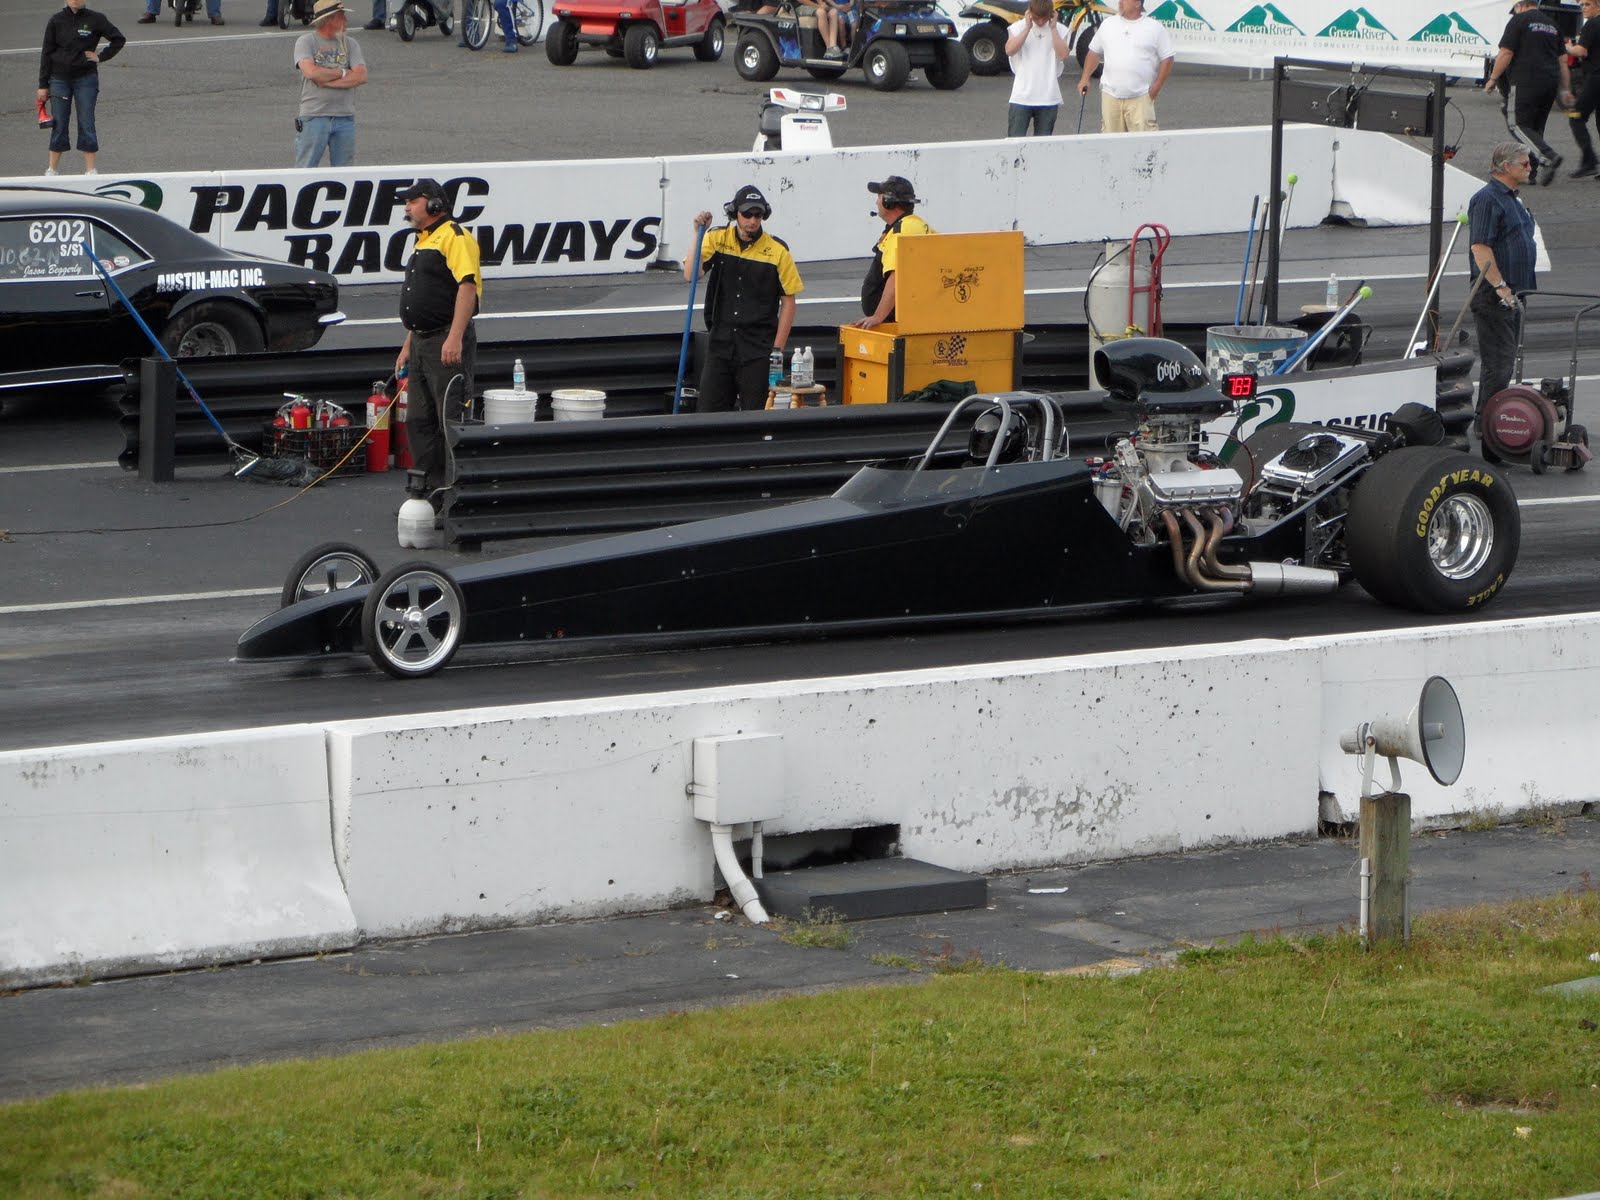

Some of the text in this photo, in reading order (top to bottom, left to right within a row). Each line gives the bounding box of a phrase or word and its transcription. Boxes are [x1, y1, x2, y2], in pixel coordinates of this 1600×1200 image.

[1180, 18, 1204, 31] River
[1237, 21, 1294, 36] Green River
[1328, 25, 1387, 41] Green River
[1421, 30, 1479, 45] Green River
[189, 176, 490, 234] PACIFC
[29, 220, 86, 243] 6202
[284, 216, 662, 275] RACWAYS
[23, 265, 46, 278] Jason
[156, 267, 266, 293] AUSTIN-MAC INC.
